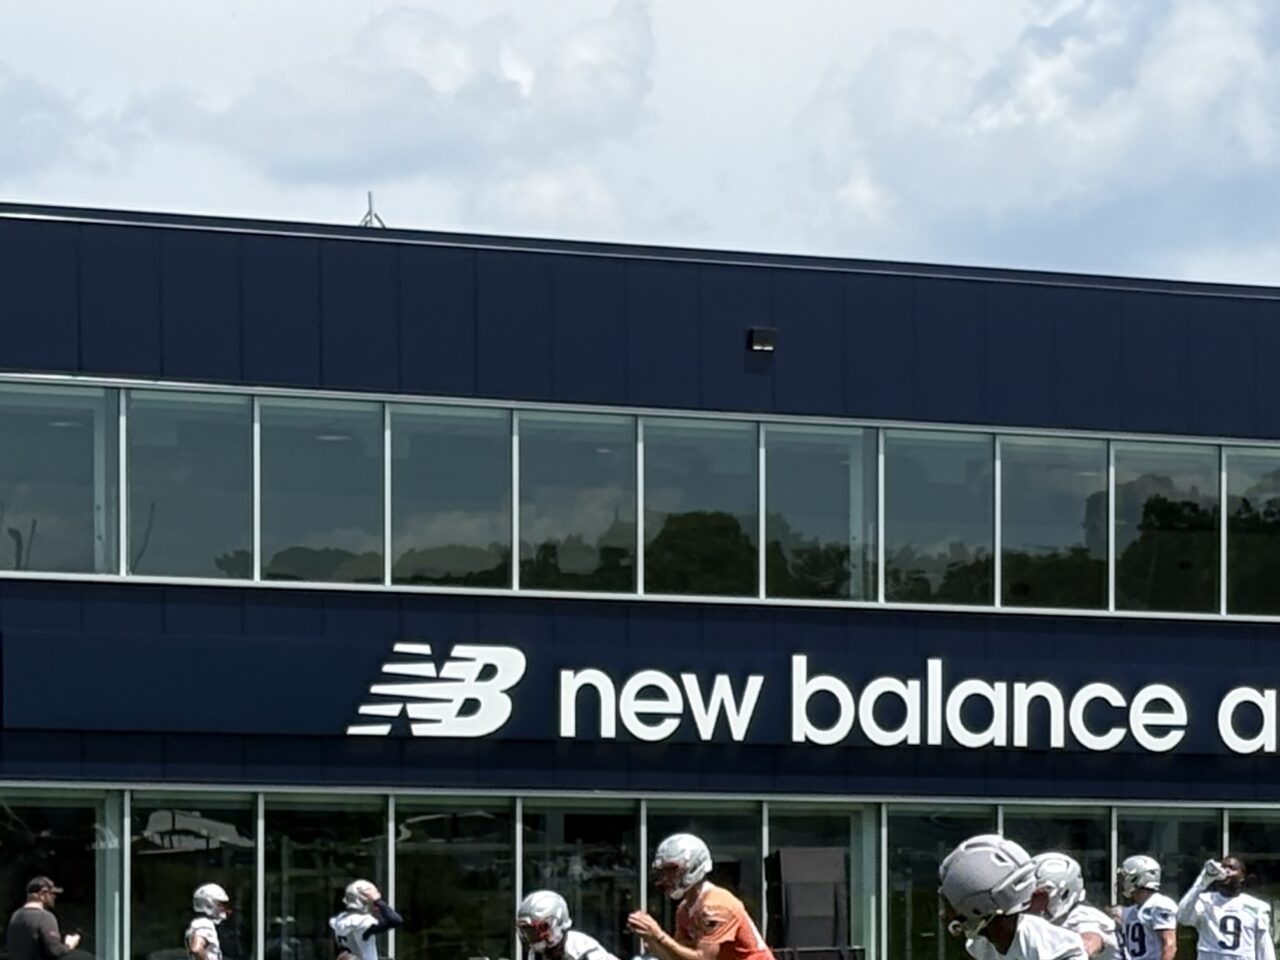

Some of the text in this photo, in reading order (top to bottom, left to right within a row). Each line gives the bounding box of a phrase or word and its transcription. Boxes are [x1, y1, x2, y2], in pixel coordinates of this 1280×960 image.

[560, 669, 764, 741] new
[792, 655, 1187, 751] balance
[1219, 915, 1242, 950] 9
